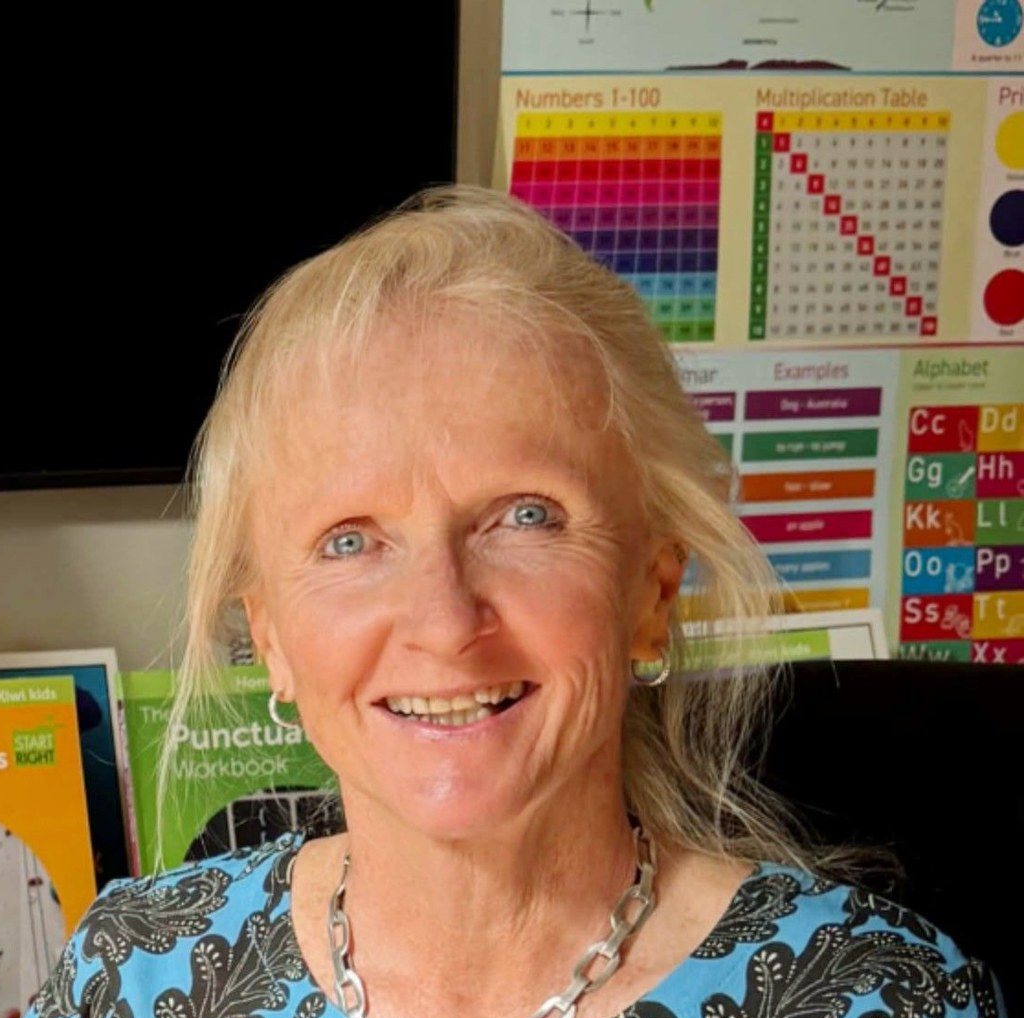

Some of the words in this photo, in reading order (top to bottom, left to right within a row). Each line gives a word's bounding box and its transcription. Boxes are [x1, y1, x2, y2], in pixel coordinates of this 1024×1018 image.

[515, 88, 604, 108] Numbers
[612, 87, 661, 107] 1-100
[756, 88, 876, 109] Multiplication
[881, 88, 928, 107] Table
[774, 362, 849, 381] Examples
[914, 358, 989, 380] Alphabet
[911, 408, 947, 436] Cc
[982, 406, 1018, 434] Dd
[908, 456, 943, 489] Gg
[978, 454, 1014, 480] Hh
[906, 503, 942, 530] Kk
[977, 549, 1011, 580] Pp
[905, 597, 940, 625] Ss
[28, 687, 57, 701] kids
[14, 733, 54, 750] START
[15, 749, 55, 766] RIGHT
[176, 756, 290, 780] Workbook
